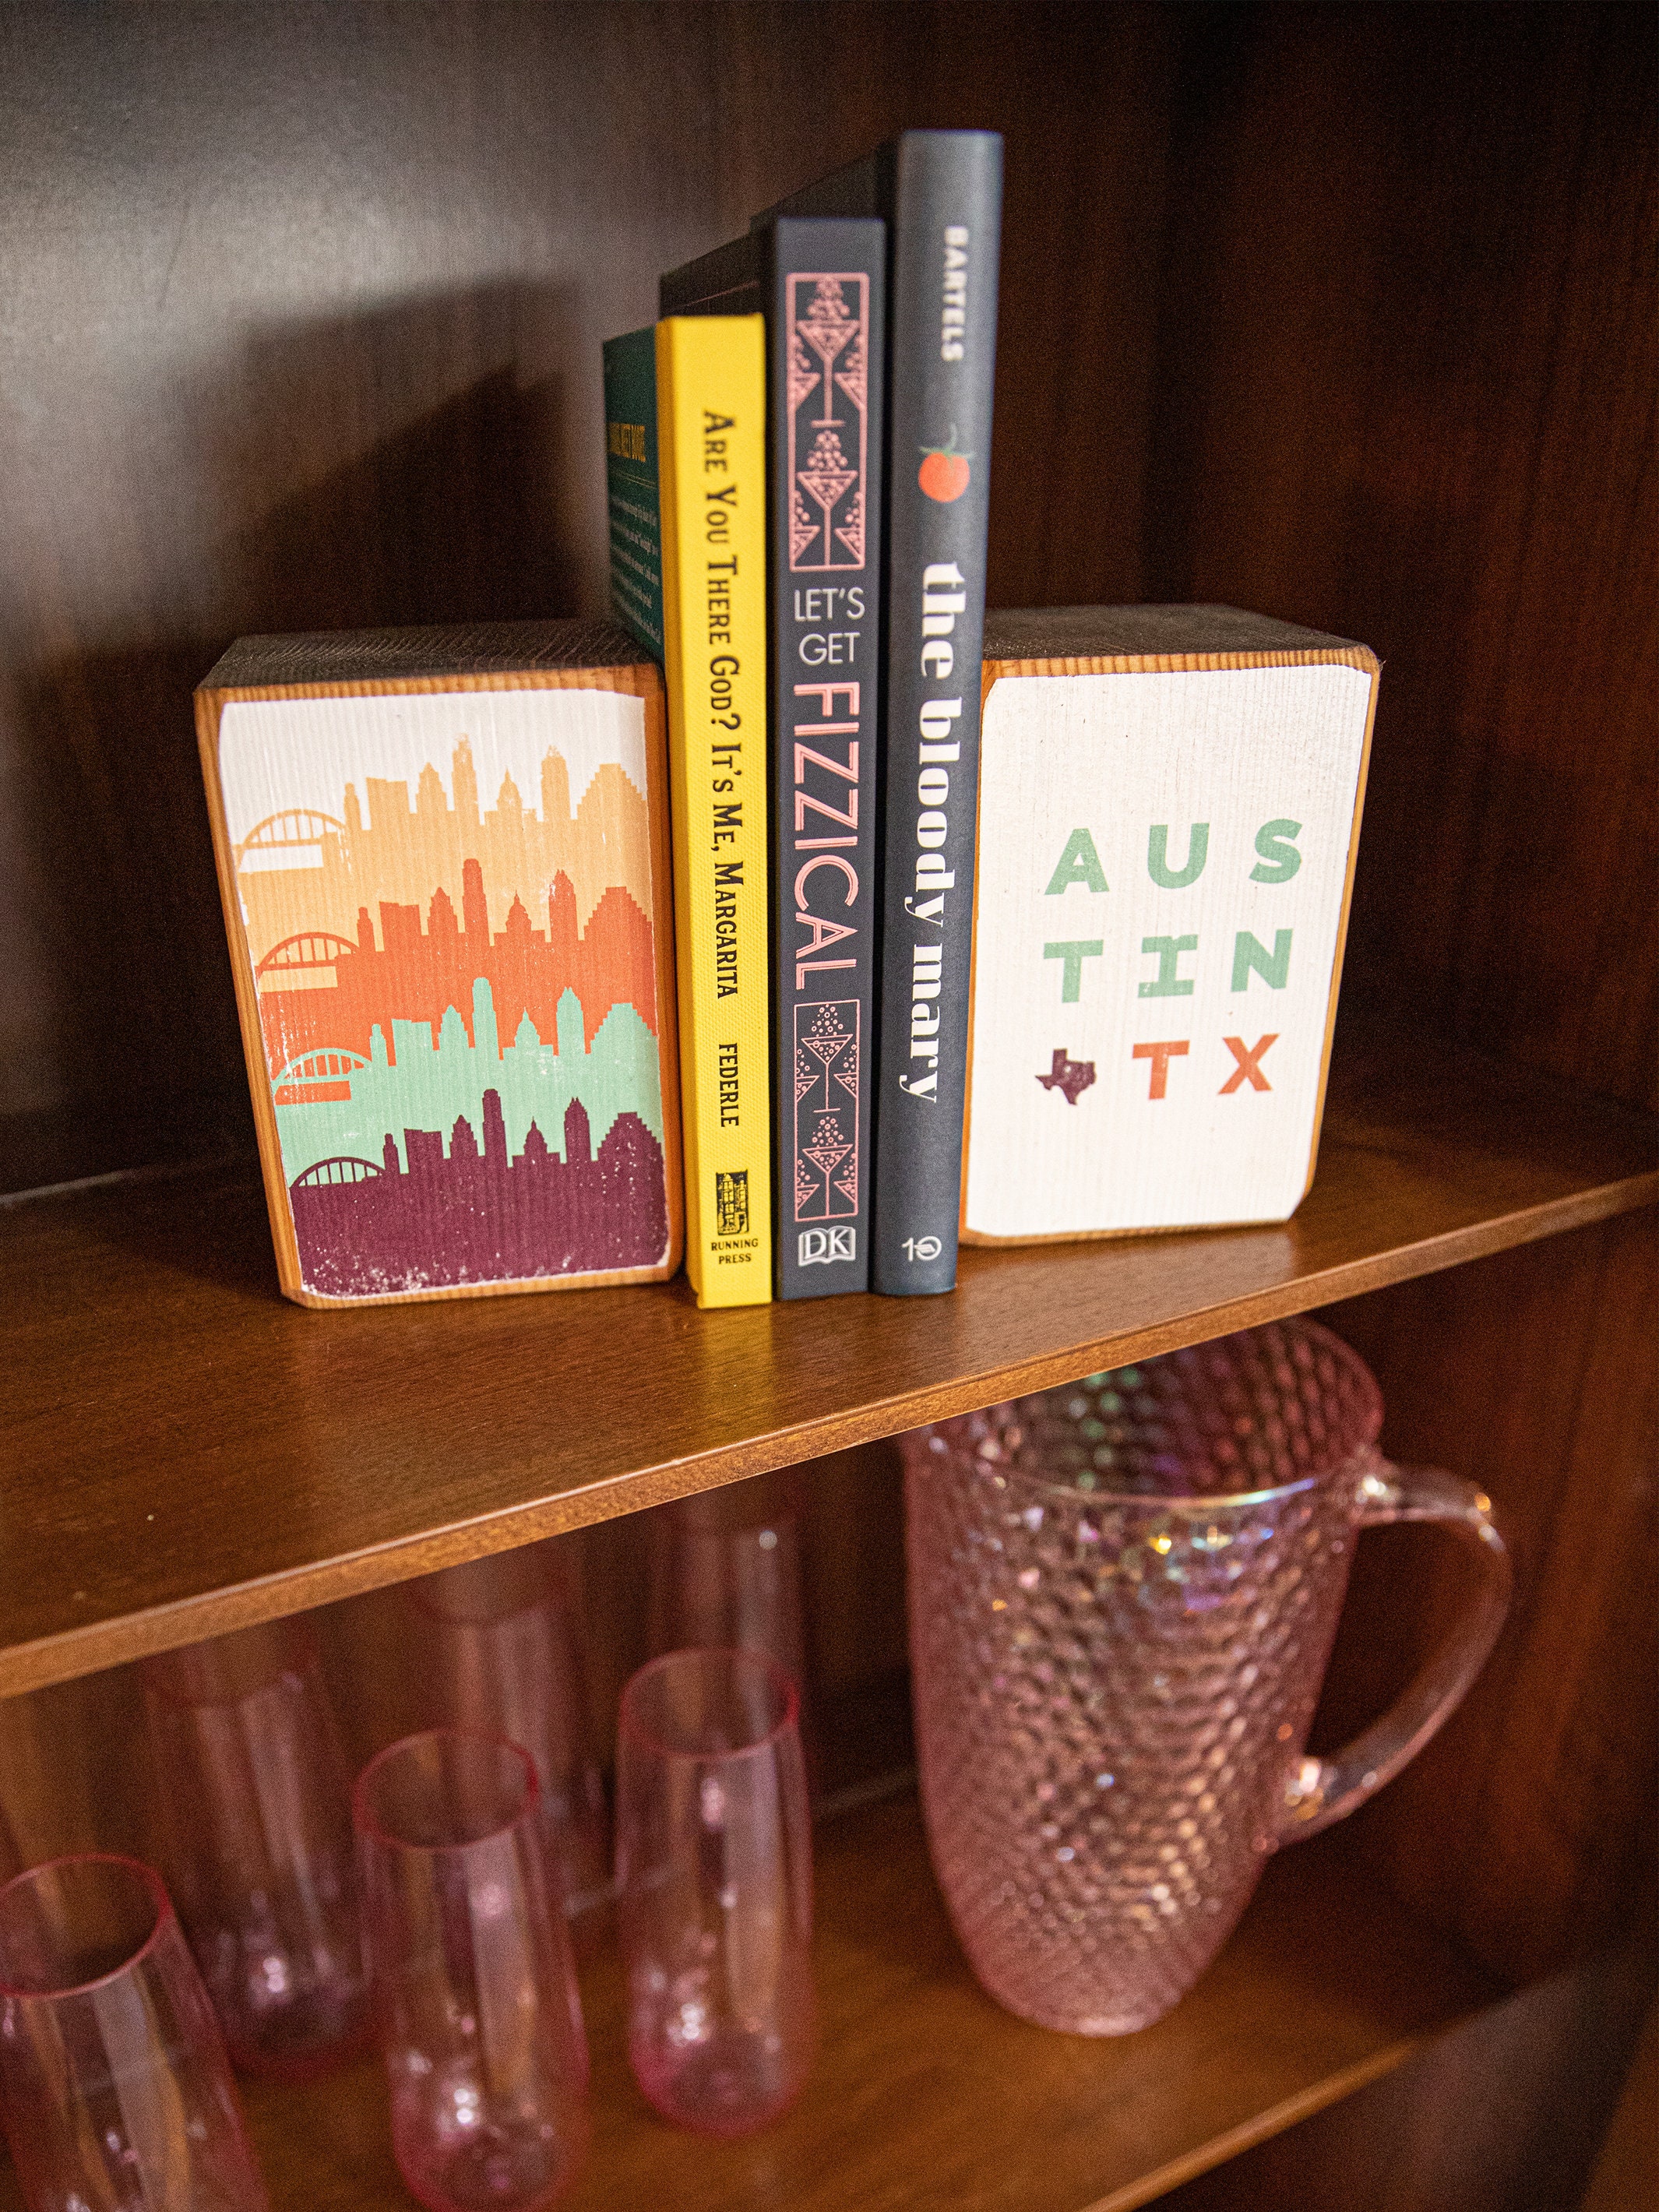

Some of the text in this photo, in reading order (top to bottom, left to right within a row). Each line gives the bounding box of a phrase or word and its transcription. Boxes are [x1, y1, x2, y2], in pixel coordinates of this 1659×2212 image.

[794, 586, 865, 622] LET'S
[798, 632, 861, 666] GET
[794, 682, 861, 990] FIZZICAL
[899, 561, 966, 1102] the bloody mary
[718, 1042, 740, 1128] FEDERLE
[711, 1238, 759, 1251] RUNNING
[718, 1252, 752, 1264] PRESS
[804, 1227, 851, 1259] DK
